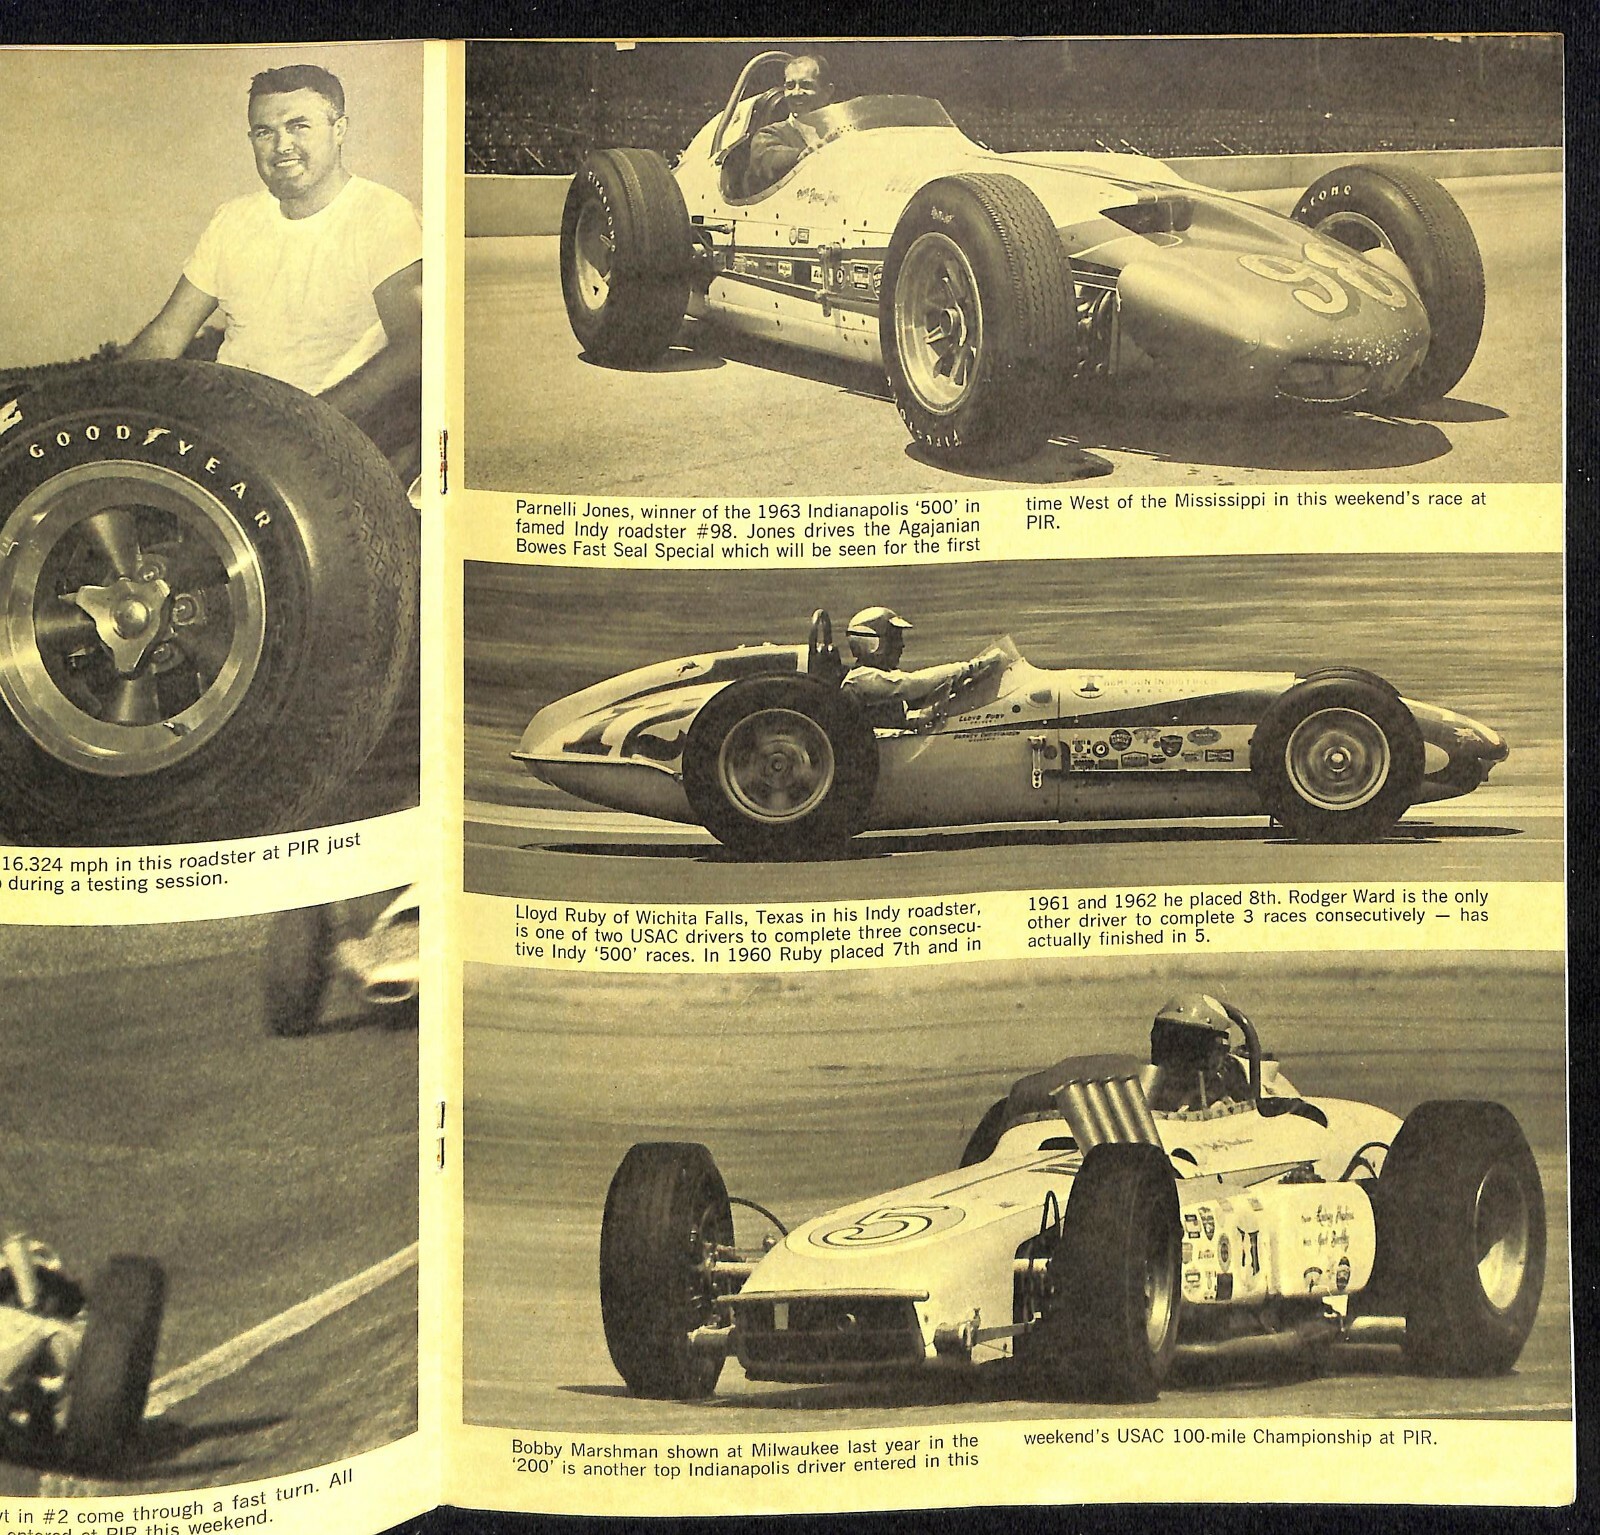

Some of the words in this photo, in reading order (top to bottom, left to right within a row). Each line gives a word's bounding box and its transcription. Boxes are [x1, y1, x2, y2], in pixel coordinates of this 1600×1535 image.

[1237, 242, 1407, 314] 98
[517, 500, 575, 516] Parnelli
[583, 503, 633, 520] Jones,
[641, 508, 696, 518] winner
[703, 505, 718, 519] of
[725, 505, 750, 519] the
[759, 504, 800, 518] 1963
[809, 502, 908, 519] Indianapolis
[966, 502, 979, 512] in
[1026, 497, 1062, 510] time
[1070, 496, 1108, 509] West
[1118, 495, 1133, 508] of
[1141, 494, 1166, 508] the
[1176, 493, 1264, 509] Mississippi
[1275, 492, 1288, 505] in
[1297, 492, 1326, 505] this
[1429, 495, 1462, 505] race
[1472, 493, 1486, 505] at
[516, 519, 564, 535] famed
[576, 521, 608, 540] Indy
[619, 524, 686, 538] roadster
[697, 524, 736, 538] #98.
[747, 524, 795, 538] Jones
[805, 523, 854, 538] drives
[864, 521, 890, 536] the
[899, 518, 979, 538] Agajanian
[1028, 515, 1059, 529] PIR.
[517, 538, 566, 554] Bowes
[574, 541, 606, 556] Fast
[614, 542, 647, 557] Seal
[656, 543, 713, 560] Special
[722, 543, 768, 558] which
[777, 543, 803, 557] will
[813, 543, 831, 557] be
[839, 545, 875, 556] seen
[884, 540, 907, 554] for
[914, 539, 939, 553] the
[947, 538, 980, 552] first
[4, 856, 63, 871] 16.324
[71, 858, 107, 875] mph
[117, 857, 130, 871] in
[138, 855, 171, 870] this
[180, 851, 255, 868] roadster
[263, 846, 279, 860] at
[289, 839, 318, 857] PIR
[328, 835, 360, 854] just
[9, 876, 64, 894] during
[71, 881, 79, 891] a
[87, 876, 148, 893] testing
[156, 872, 227, 889] session.
[1030, 896, 1068, 910] 1961
[1078, 895, 1106, 909] and
[1116, 893, 1156, 908] 1962
[1165, 893, 1182, 906] he
[1191, 891, 1241, 909] placed
[1250, 891, 1280, 904] 8th.
[1290, 890, 1347, 907] Rodger
[1353, 889, 1394, 903] Ward
[1404, 893, 1415, 903] is
[1422, 889, 1447, 903] the
[1455, 889, 1488, 906] only
[517, 904, 556, 923] Lloyd
[566, 908, 606, 926] Ruby
[614, 910, 629, 923] of
[636, 911, 696, 925] Wichita
[706, 911, 747, 926] Falls,
[756, 911, 803, 924] Texas
[812, 909, 825, 922] in
[834, 908, 857, 921] his
[867, 905, 900, 922] Indy
[909, 902, 980, 918] roadster,
[1028, 915, 1070, 929] other
[1079, 914, 1127, 927] driver
[1136, 913, 1151, 925] to
[1161, 910, 1234, 927] complete
[1244, 910, 1253, 923] 3
[1265, 912, 1306, 922] races
[1316, 908, 1425, 924] consecutively
[1461, 908, 1488, 921] has
[517, 927, 528, 937] is
[536, 928, 564, 940] one
[572, 927, 587, 941] of
[595, 929, 622, 942] two
[632, 929, 677, 943] USAC
[686, 930, 743, 943] drivers
[751, 930, 766, 943] to
[775, 927, 850, 944] complete
[859, 925, 901, 939] three
[910, 922, 981, 939] consecu-
[1028, 933, 1091, 949] actually
[1099, 930, 1163, 945] finished
[1173, 933, 1186, 943] in
[1196, 929, 1209, 942] 5.
[516, 942, 543, 957] tive
[553, 944, 586, 963] Indy
[647, 952, 694, 962] races.
[705, 948, 718, 962] In
[729, 948, 771, 961] 1960
[781, 947, 822, 963] Ruby
[831, 943, 883, 962] placed
[893, 942, 919, 956] 7th
[929, 938, 957, 954] and
[968, 940, 980, 951] in
[822, 1206, 952, 1247] 5
[513, 1439, 562, 1458] Bobby
[572, 1443, 657, 1458] Marshman
[668, 1445, 718, 1458] shown
[728, 1445, 742, 1457] at
[753, 1442, 838, 1457] Milwaukee
[849, 1440, 876, 1453] last
[886, 1440, 920, 1455] year
[930, 1436, 943, 1449] in
[953, 1434, 978, 1447] the
[1118, 1429, 1163, 1443] USAC
[1174, 1429, 1245, 1443] 100-mile
[1254, 1429, 1371, 1447] Championship
[1380, 1431, 1394, 1444] at
[1404, 1430, 1436, 1444] PIR.
[563, 1461, 575, 1474] is
[584, 1463, 646, 1476] another
[654, 1464, 680, 1479] top
[690, 1461, 789, 1478] Indianapolis
[798, 1460, 845, 1473] driver
[855, 1455, 915, 1471] entered
[926, 1454, 939, 1467] in
[948, 1452, 978, 1466] this
[19, 1509, 32, 1523] in
[43, 1509, 67, 1524] #2
[78, 1512, 123, 1523] come
[134, 1501, 202, 1520] through
[214, 1502, 222, 1512] a
[233, 1492, 265, 1509] fast
[276, 1484, 318, 1500] turn.
[330, 1469, 351, 1488] All
[148, 1525, 179, 1535] this
[189, 1509, 272, 1534] weekend.
